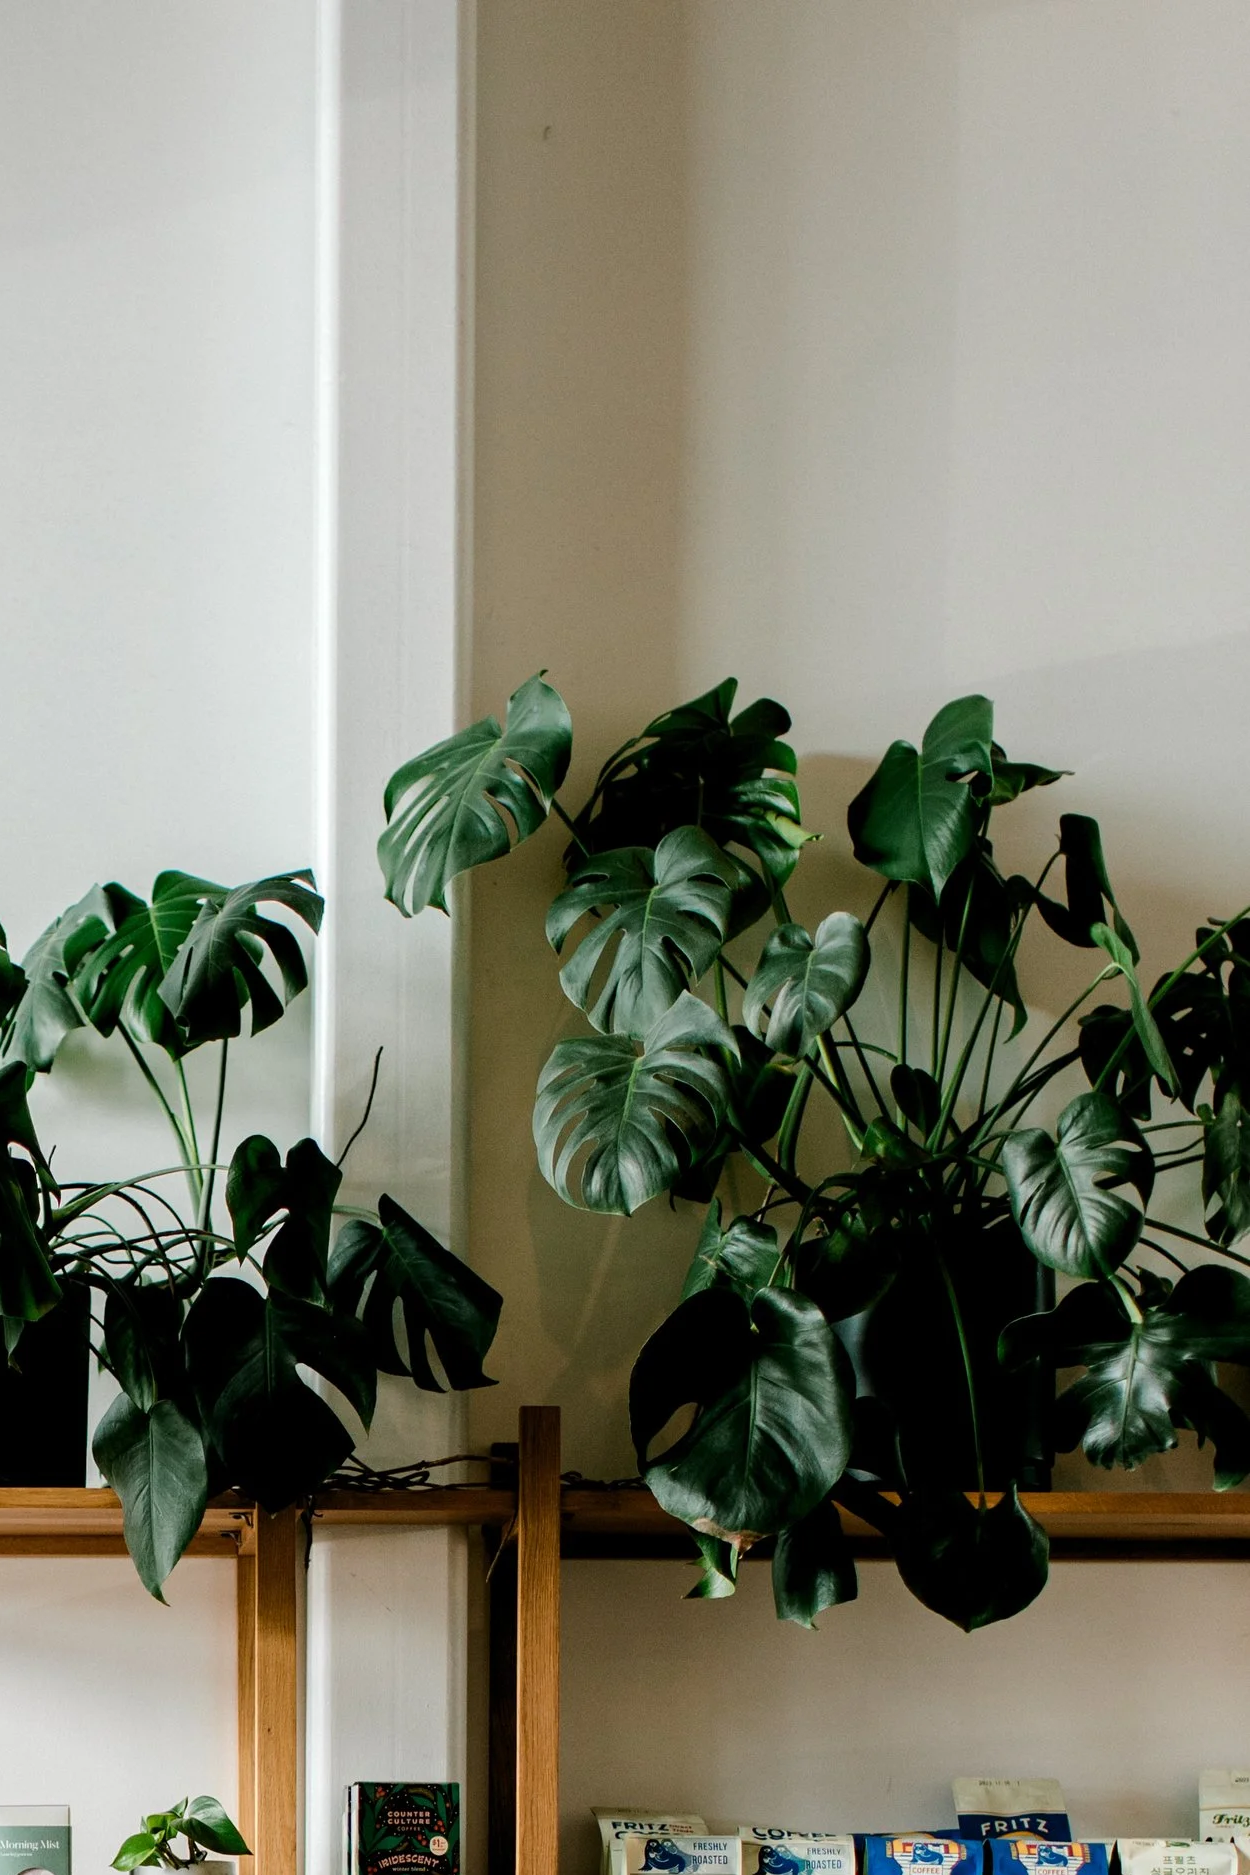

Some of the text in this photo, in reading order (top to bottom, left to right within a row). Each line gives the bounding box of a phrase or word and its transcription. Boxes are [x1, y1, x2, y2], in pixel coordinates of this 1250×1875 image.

[611, 1821, 669, 1831] FRITZ
[981, 1818, 1048, 1836] FRITZ
[0, 1840, 60, 1851] Morning Mist
[693, 1842, 727, 1851] FRESHLY
[378, 1854, 439, 1869] IRIDESCENT
[692, 1855, 728, 1865] ROASTED
[805, 1860, 842, 1869] ROASTED
